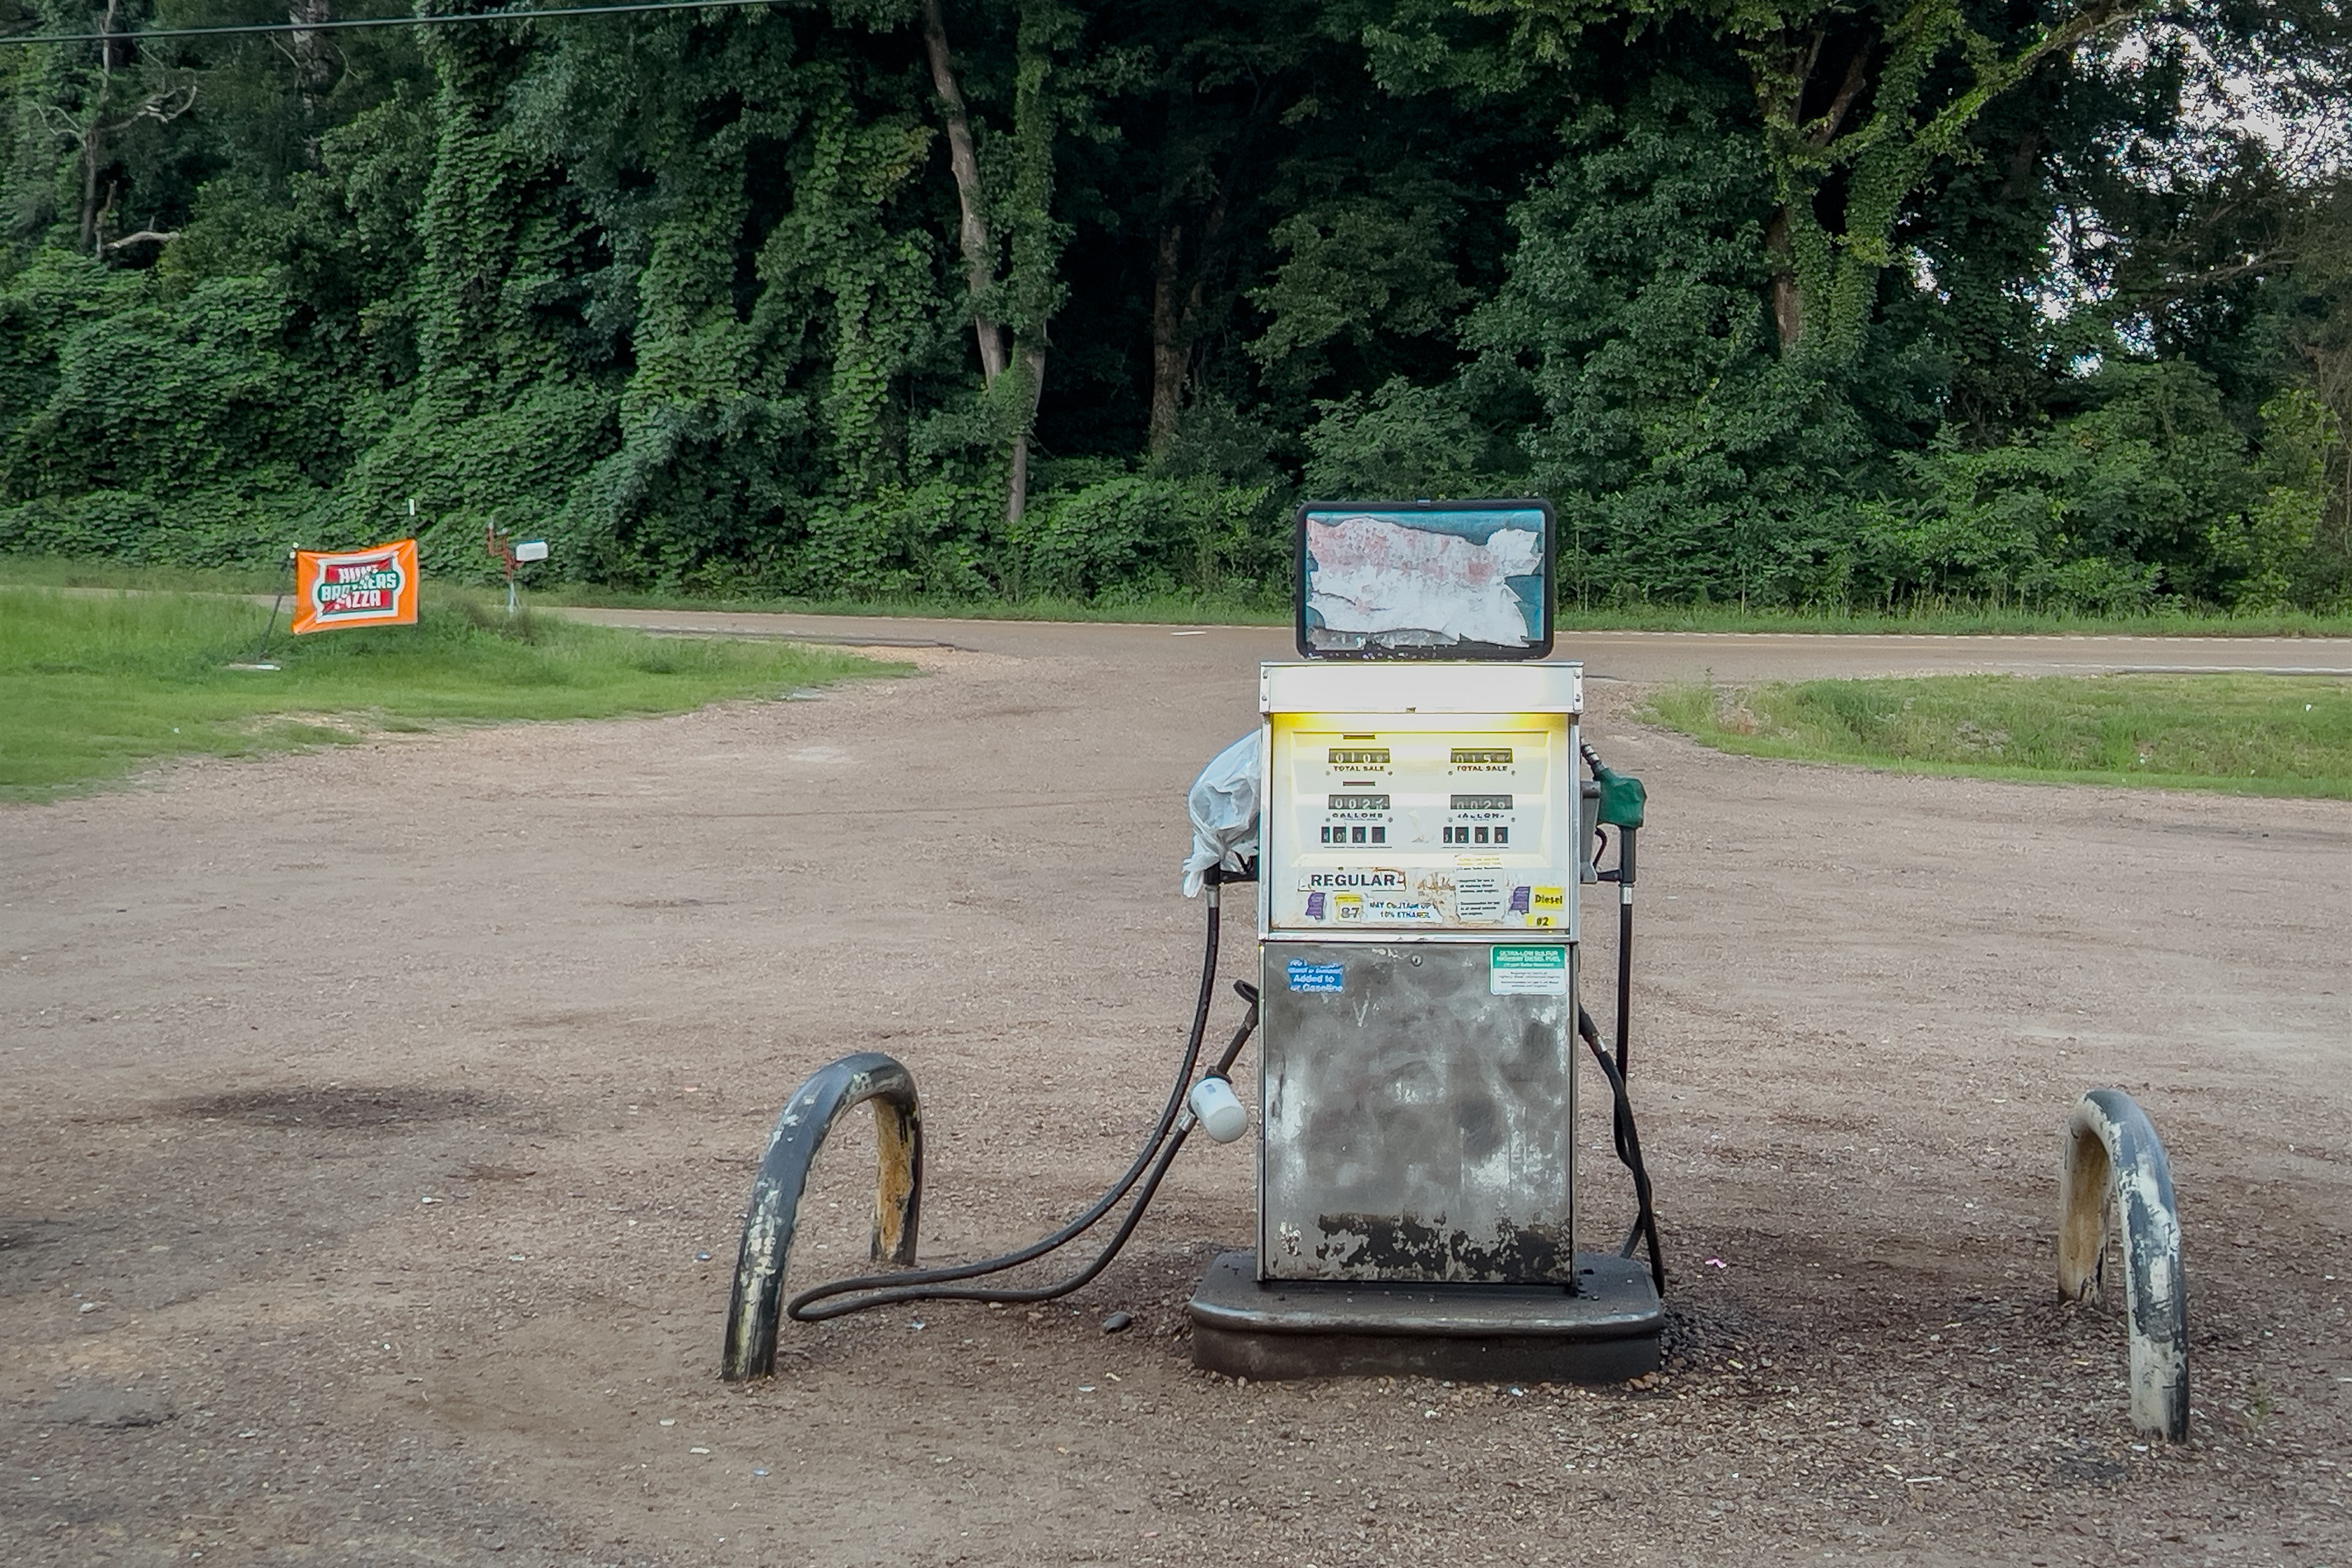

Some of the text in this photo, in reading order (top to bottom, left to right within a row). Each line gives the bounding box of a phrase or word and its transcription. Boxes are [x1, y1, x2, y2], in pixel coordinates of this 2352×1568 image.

[336, 590, 382, 609] IZZA
[1311, 873, 1396, 888] REGULAR
[1534, 894, 1563, 905] Diesel
[1341, 907, 1360, 919] 87
[1536, 916, 1549, 927] #2
[1293, 974, 1335, 984] Added to
